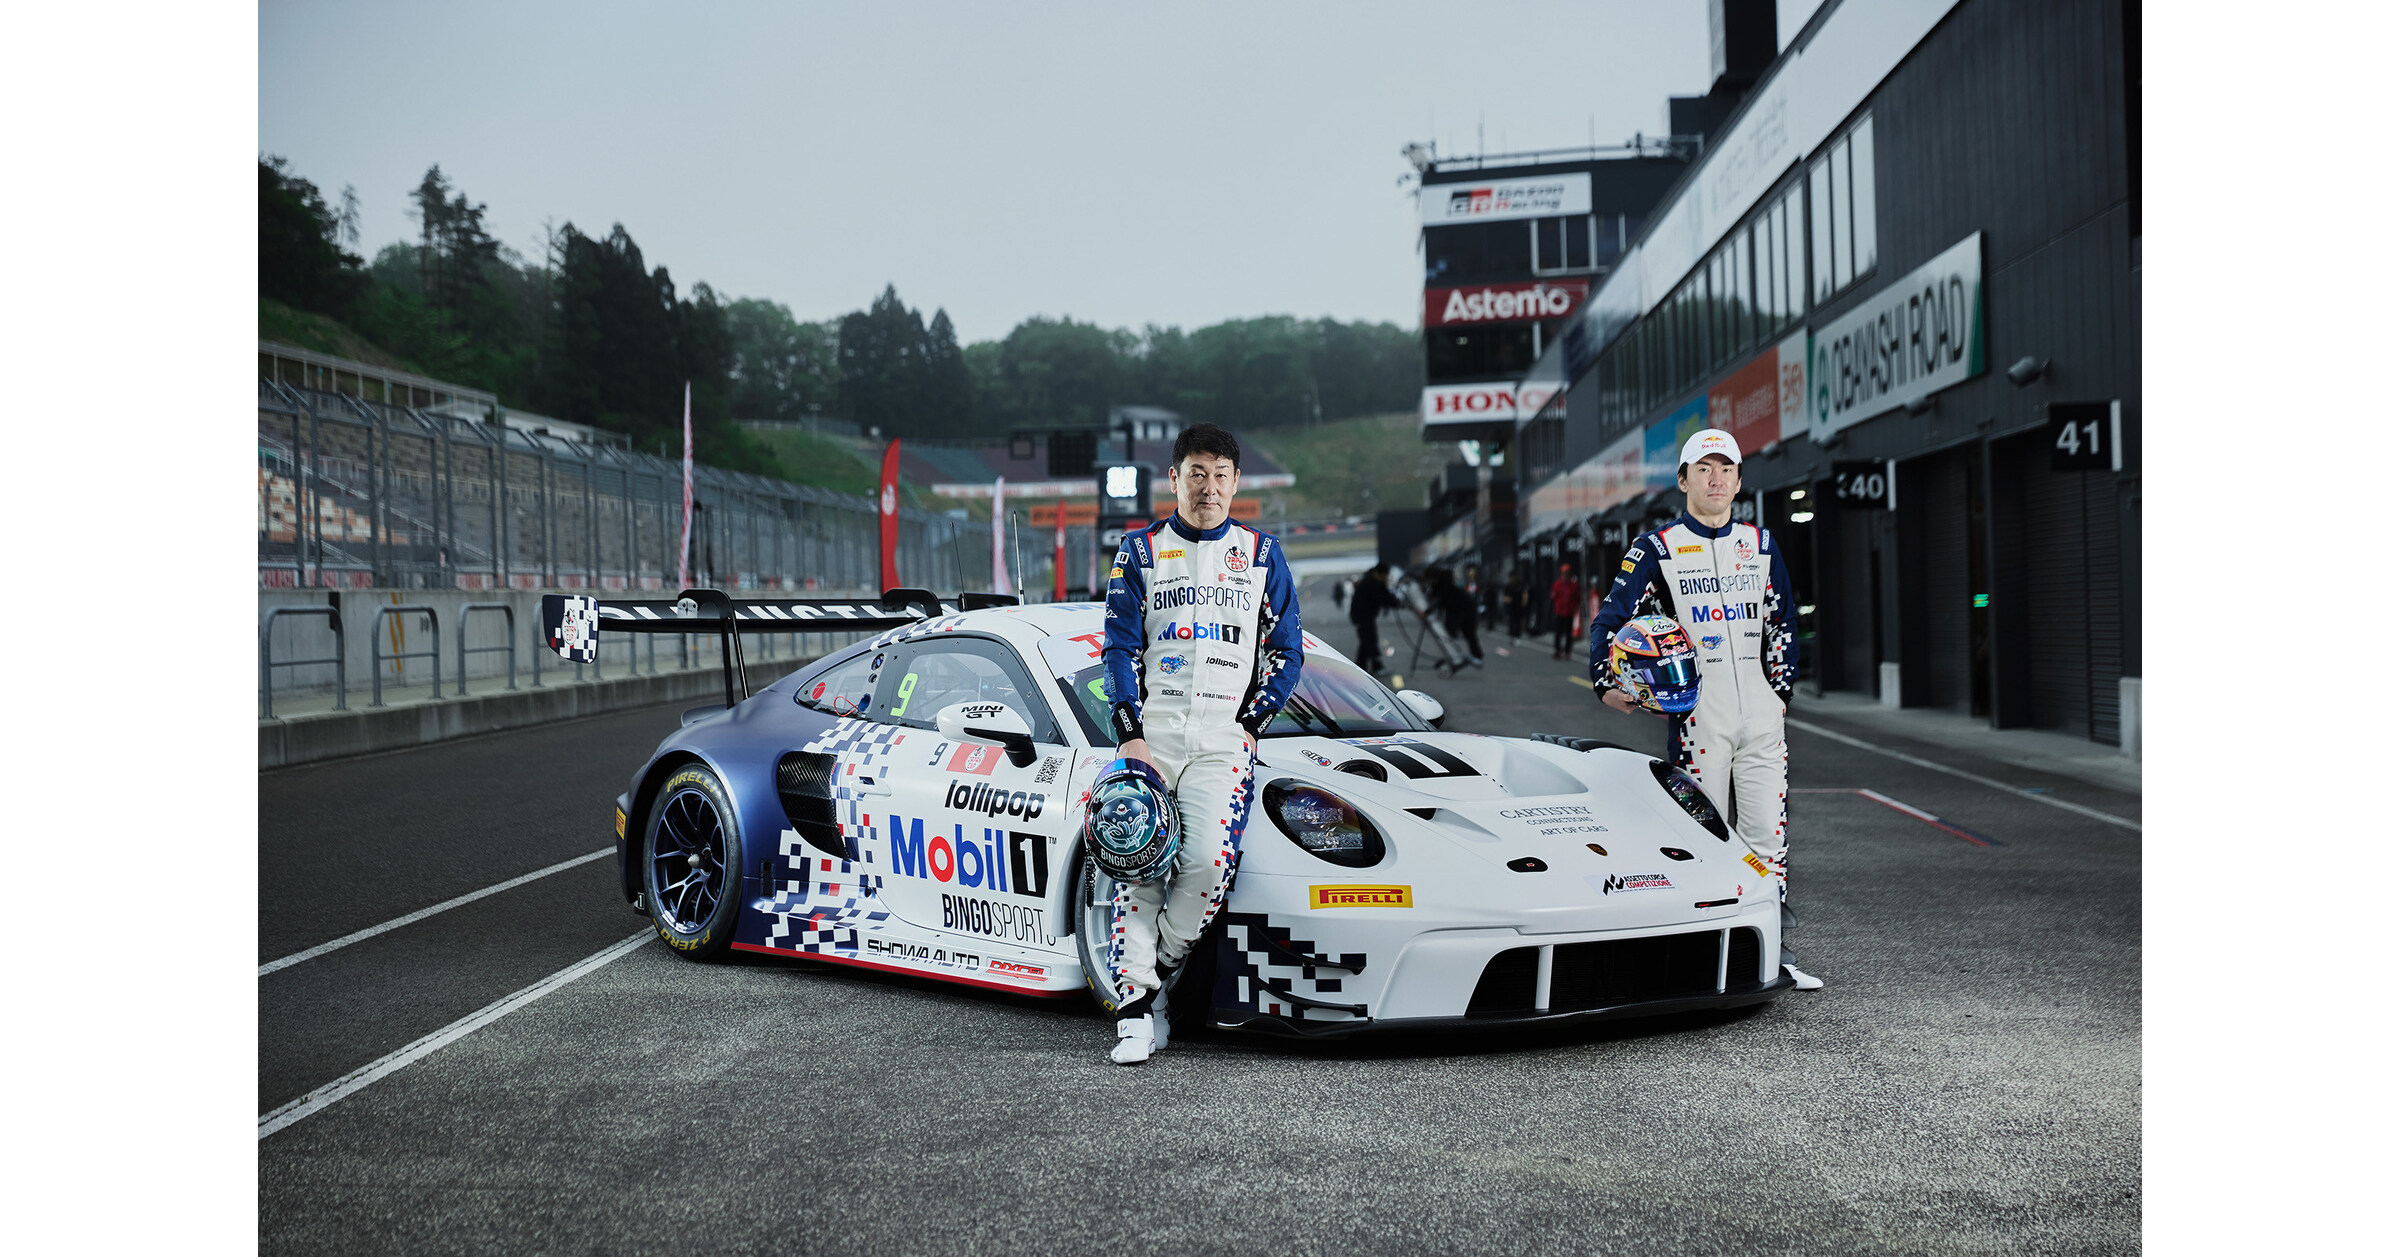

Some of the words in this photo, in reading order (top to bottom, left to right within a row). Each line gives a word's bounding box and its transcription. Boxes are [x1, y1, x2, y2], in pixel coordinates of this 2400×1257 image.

[1442, 285, 1570, 323] Astemo
[1831, 302, 1908, 416] OBAYASHI
[1909, 273, 1966, 380] ROAD
[1435, 391, 1515, 413] HON
[2056, 420, 2099, 455] 41
[1850, 473, 1884, 499] 40
[1133, 537, 1149, 565] sparco
[1258, 537, 1273, 563] sparco
[1206, 656, 1239, 669] lollipop
[891, 672, 918, 716] 9
[1161, 688, 1184, 697] sparco
[961, 705, 1004, 713] MINI
[966, 711, 1002, 719] GT
[1118, 708, 1134, 733] sparco
[928, 742, 949, 766] 9
[944, 779, 1045, 822] lollipop
[1500, 806, 1592, 819] CARTISTRY
[1526, 816, 1594, 826] CONNECTIONS
[1540, 827, 1562, 836] ART
[1579, 825, 1609, 833] CARS
[1319, 888, 1404, 904] PIRELLI
[1625, 879, 1673, 889] COMPETIZIONE
[660, 927, 701, 951] ZERO
